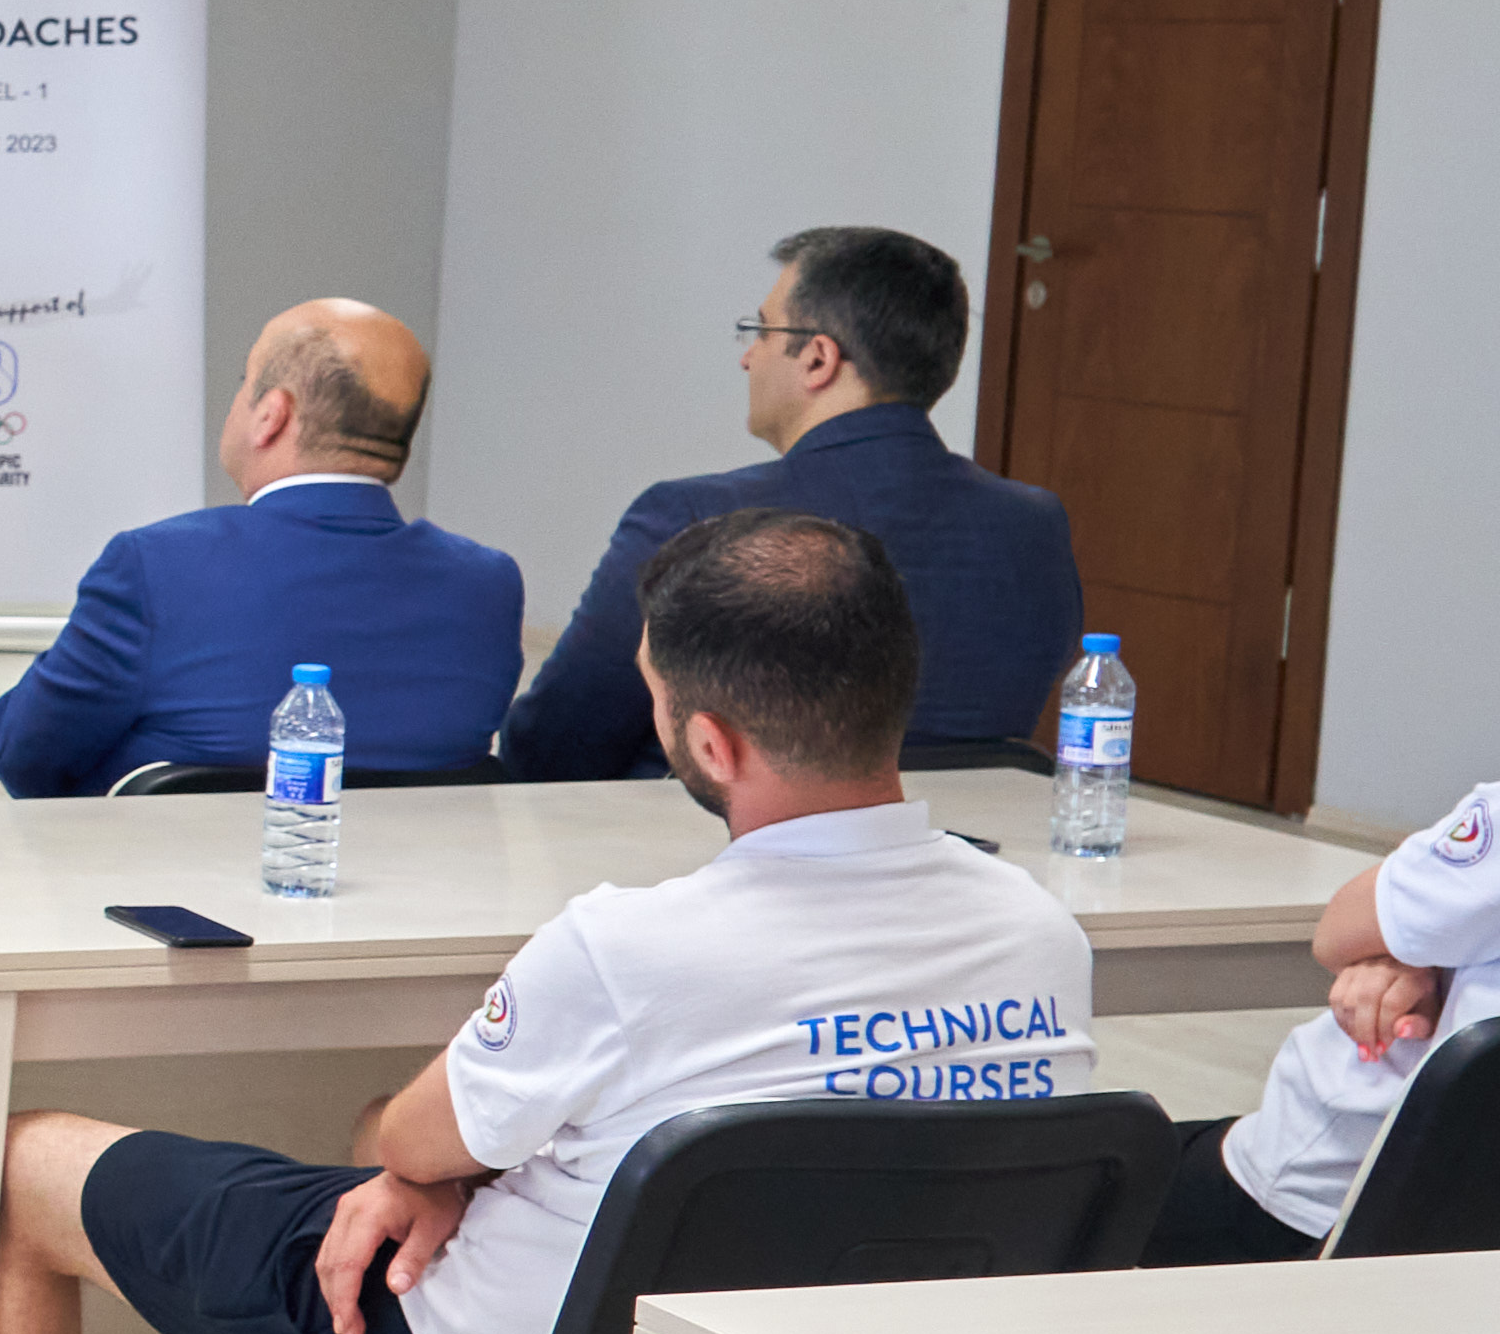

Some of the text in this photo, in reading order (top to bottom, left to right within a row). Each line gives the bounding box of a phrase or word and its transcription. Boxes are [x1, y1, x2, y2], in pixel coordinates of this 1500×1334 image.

[39, 82, 47, 100] 1
[6, 133, 57, 153] 2023
[66, 288, 85, 317] of
[797, 996, 1066, 1056] TECHNICAL
[826, 1058, 1054, 1100] COURSES
